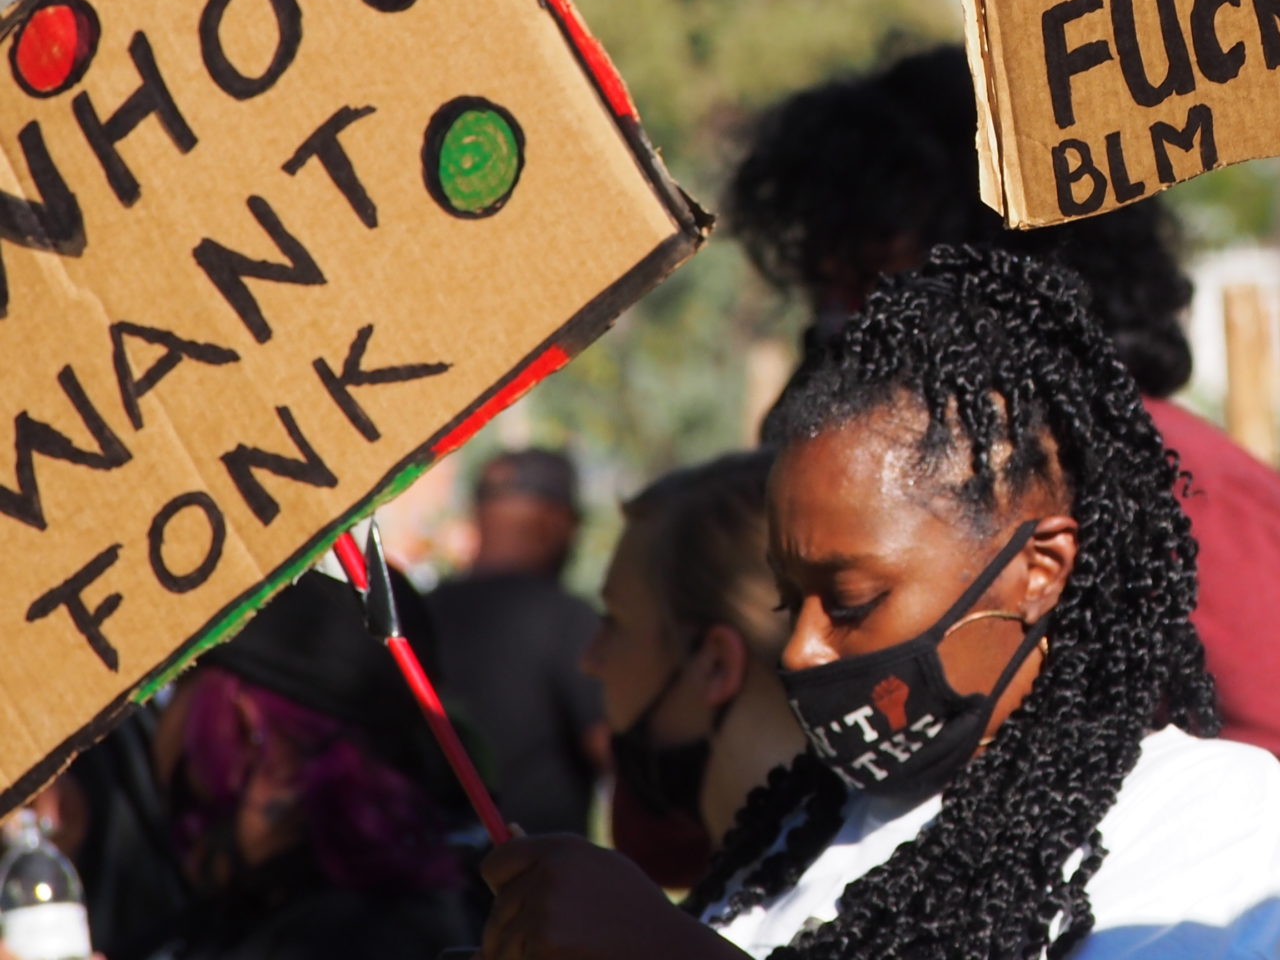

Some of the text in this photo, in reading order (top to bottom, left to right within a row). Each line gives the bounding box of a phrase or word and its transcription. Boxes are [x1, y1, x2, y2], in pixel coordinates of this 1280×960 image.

[0, 104, 379, 532] WANT
[1051, 103, 1220, 217] BLM
[24, 322, 455, 673] FONK
